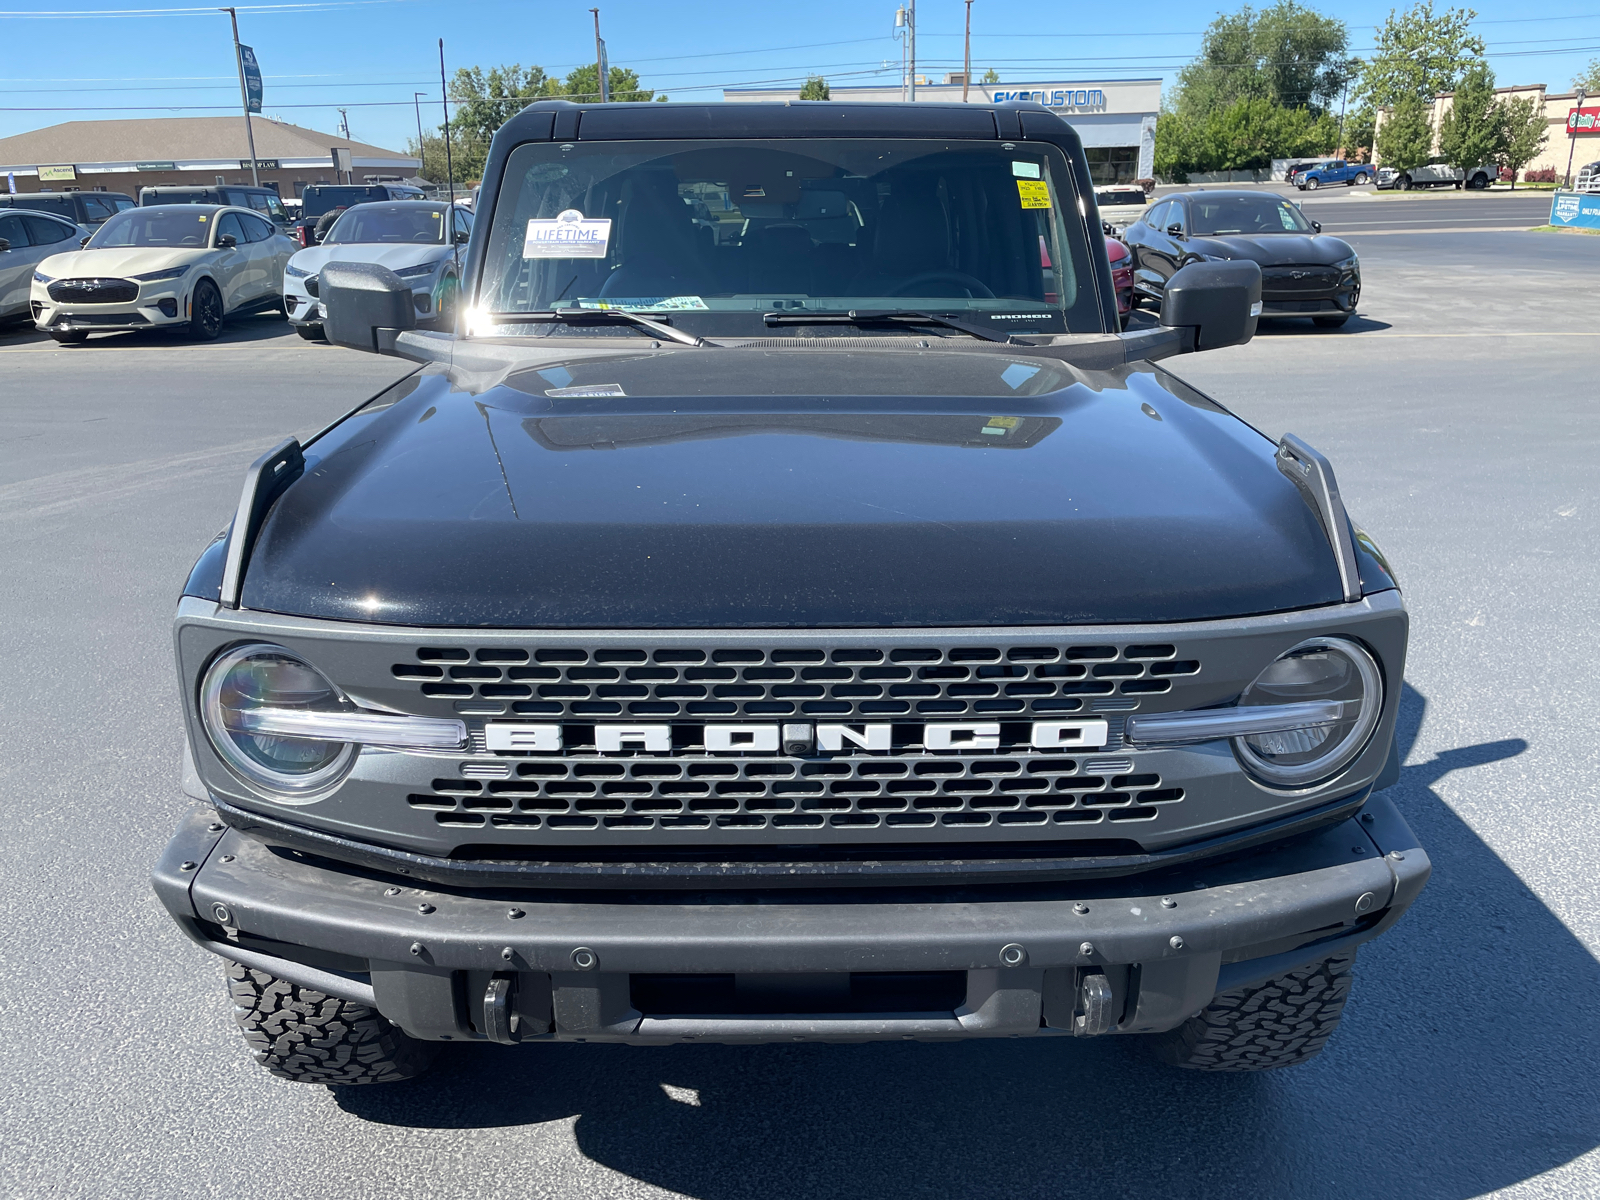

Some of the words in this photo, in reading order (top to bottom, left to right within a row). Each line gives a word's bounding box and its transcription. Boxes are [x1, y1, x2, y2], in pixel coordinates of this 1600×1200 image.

[1569, 112, 1595, 128] OReilly
[1581, 207, 1592, 215] ONLY
[536, 229, 599, 241] LIFETIME
[484, 719, 1108, 751] BRONCO
